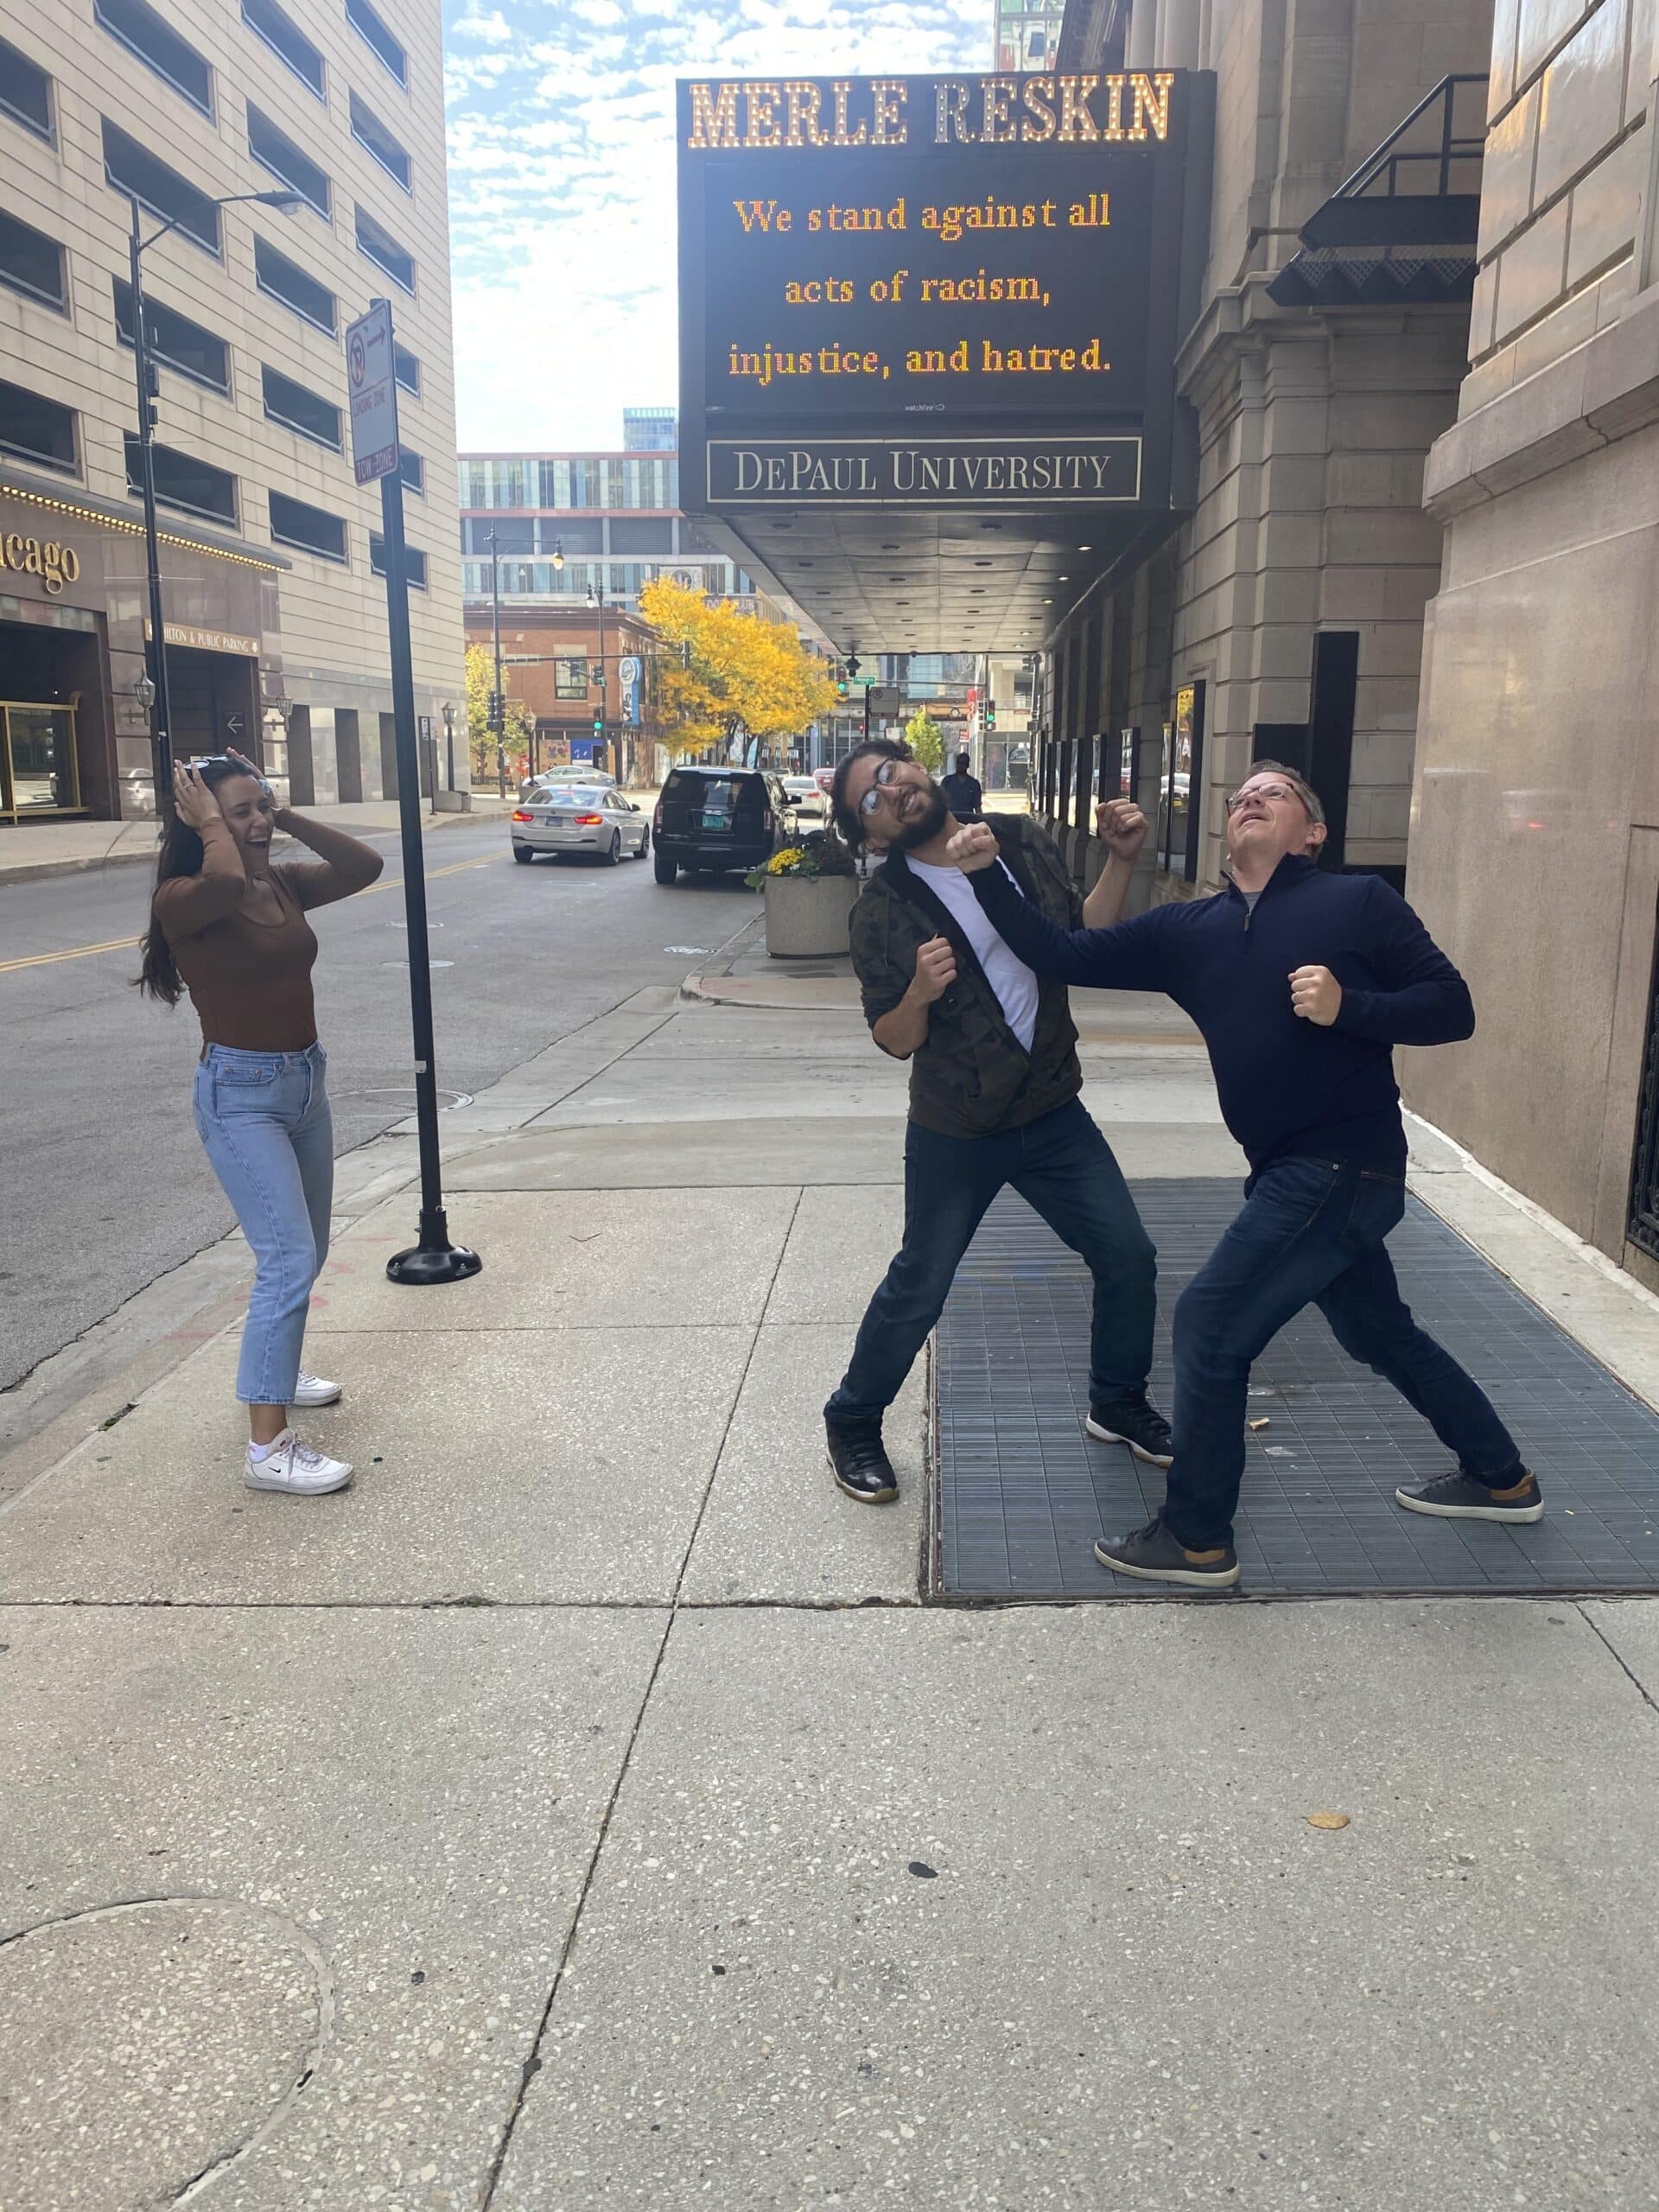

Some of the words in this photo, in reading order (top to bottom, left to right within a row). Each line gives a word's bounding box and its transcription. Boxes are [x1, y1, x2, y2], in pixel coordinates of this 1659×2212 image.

[688, 79, 908, 148] MERLE
[935, 73, 1175, 143] RESKIN
[734, 200, 792, 232] We
[807, 198, 906, 231] stand
[921, 196, 1056, 241] against
[1068, 193, 1110, 226] all
[785, 276, 854, 303] acts
[870, 270, 908, 302] of
[920, 269, 1051, 306] racism,
[728, 343, 890, 385] injustice,
[906, 340, 969, 372] and
[982, 340, 1111, 372] hatred.
[733, 451, 876, 491] DEPAUL
[888, 451, 1111, 490] UNIVERSITY
[198, 632, 220, 648] PUBLIC
[222, 637, 249, 652] PARKING
